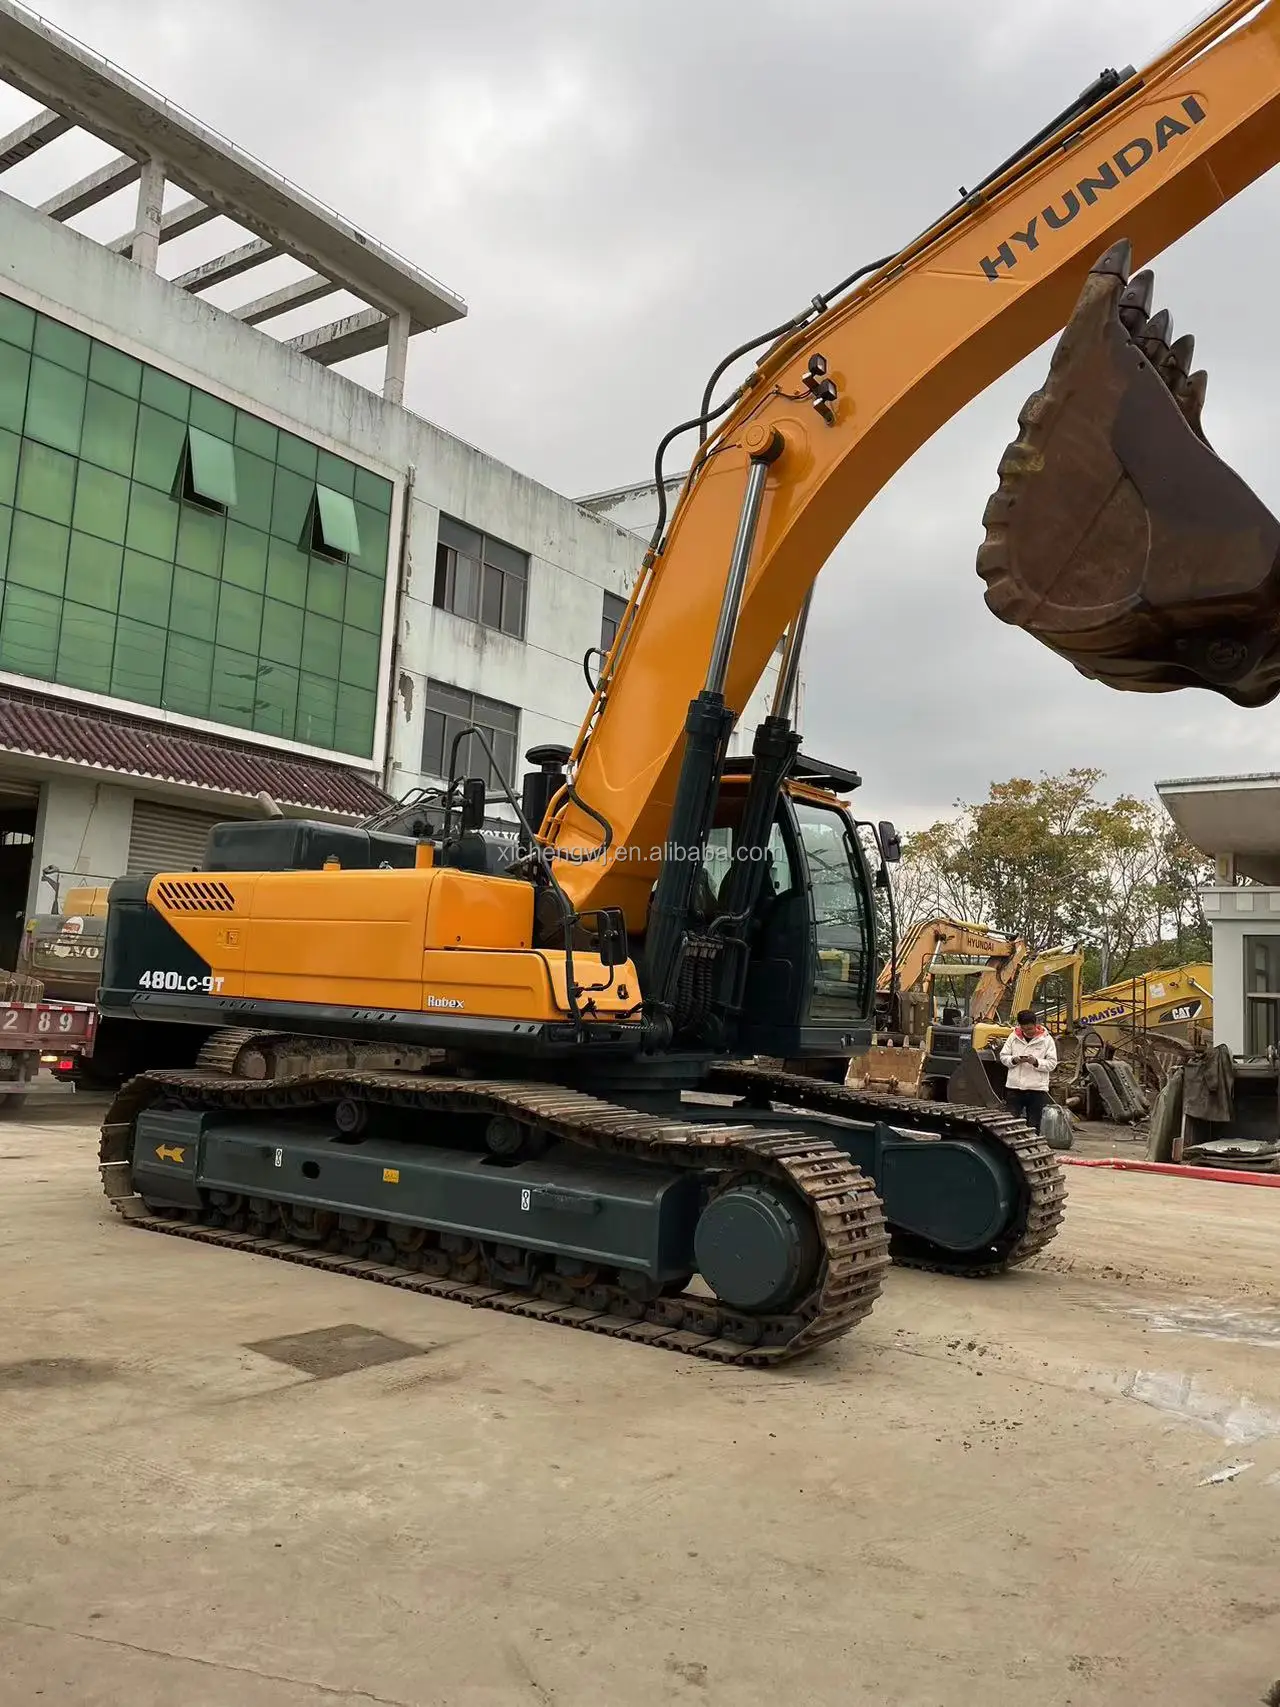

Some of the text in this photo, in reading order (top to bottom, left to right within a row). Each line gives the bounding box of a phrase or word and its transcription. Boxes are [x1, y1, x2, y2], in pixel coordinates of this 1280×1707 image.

[979, 95, 1207, 282] HYUNDAI
[44, 943, 99, 959] VLVO
[967, 937, 995, 952] HYUNDAI
[139, 970, 225, 992] 480LC-9T
[1080, 1005, 1125, 1025] OMATSU
[1172, 1006, 1191, 1020] CAT
